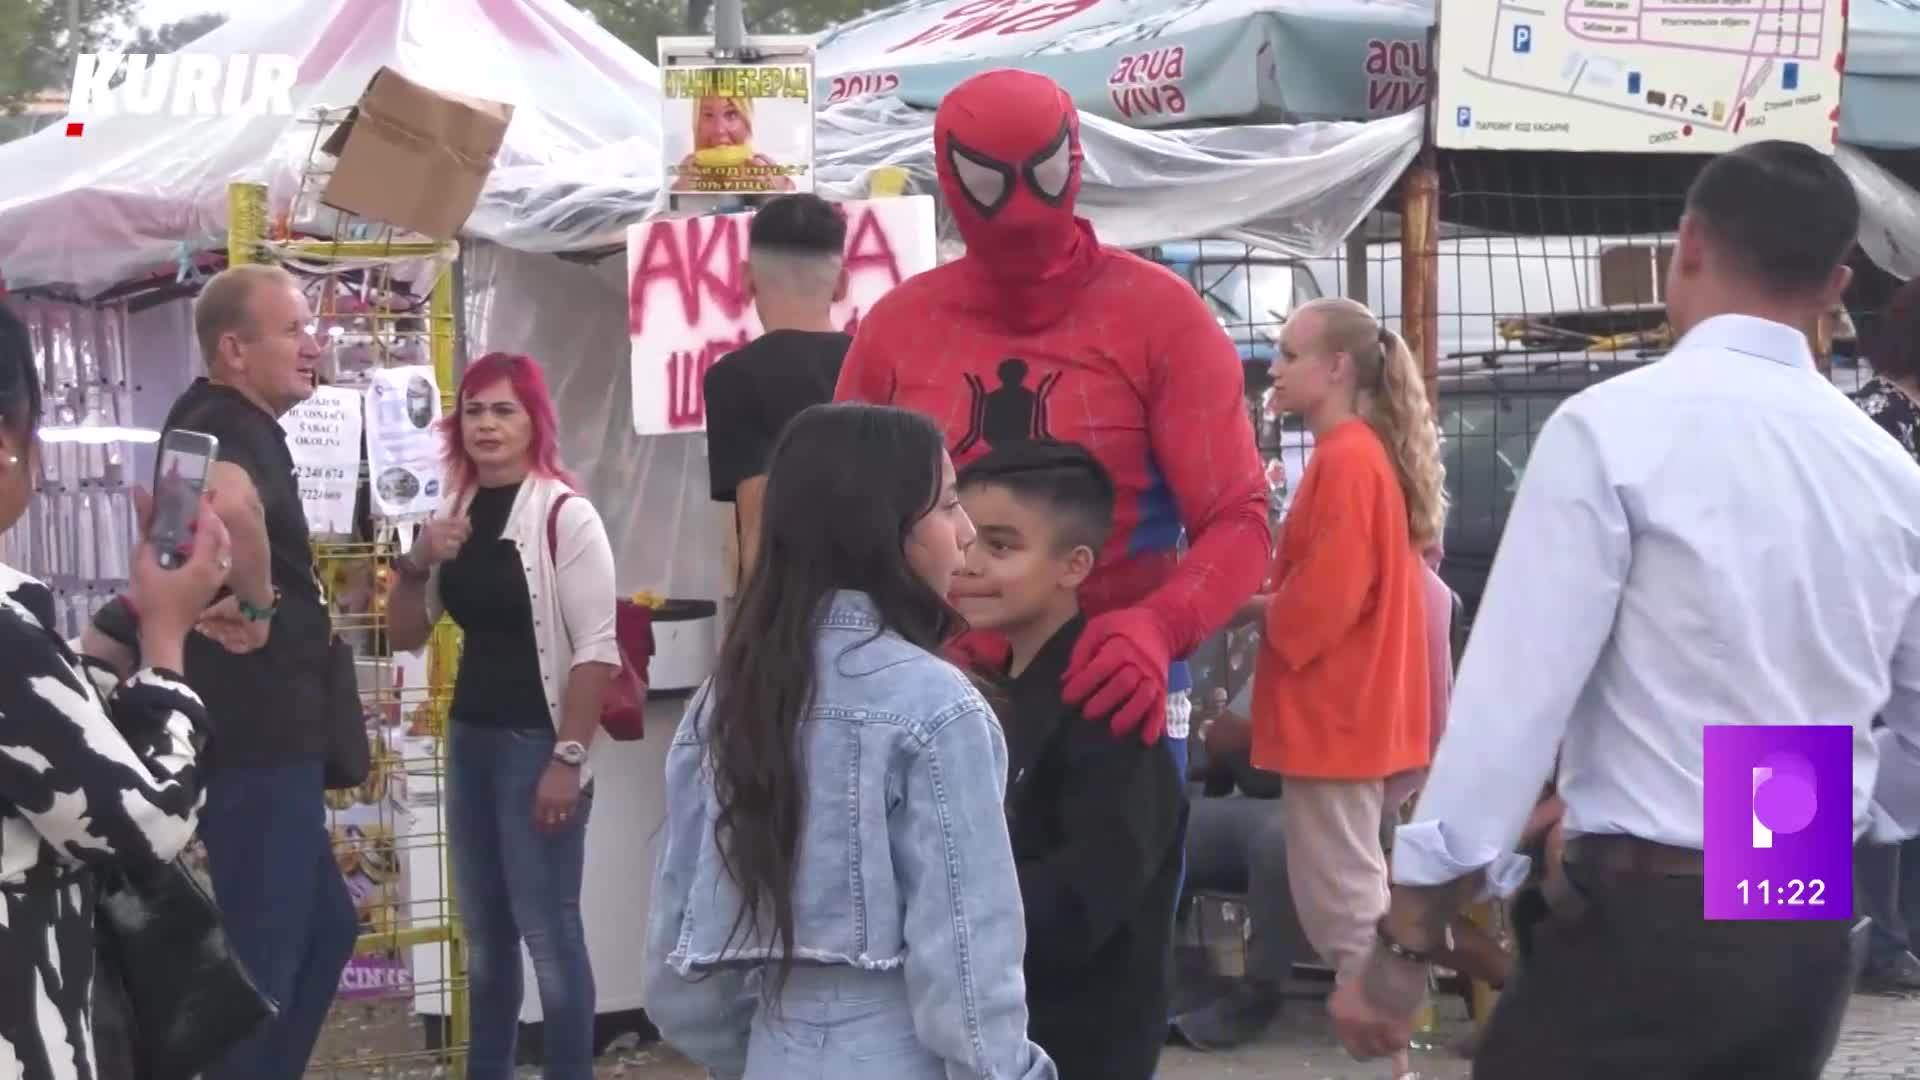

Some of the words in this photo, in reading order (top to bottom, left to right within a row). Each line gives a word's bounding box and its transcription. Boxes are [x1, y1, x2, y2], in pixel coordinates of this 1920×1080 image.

[1110, 46, 1184, 84] aqua
[1366, 40, 1427, 77] aqu
[1111, 84, 1186, 118] viva
[1369, 80, 1427, 111] viv
